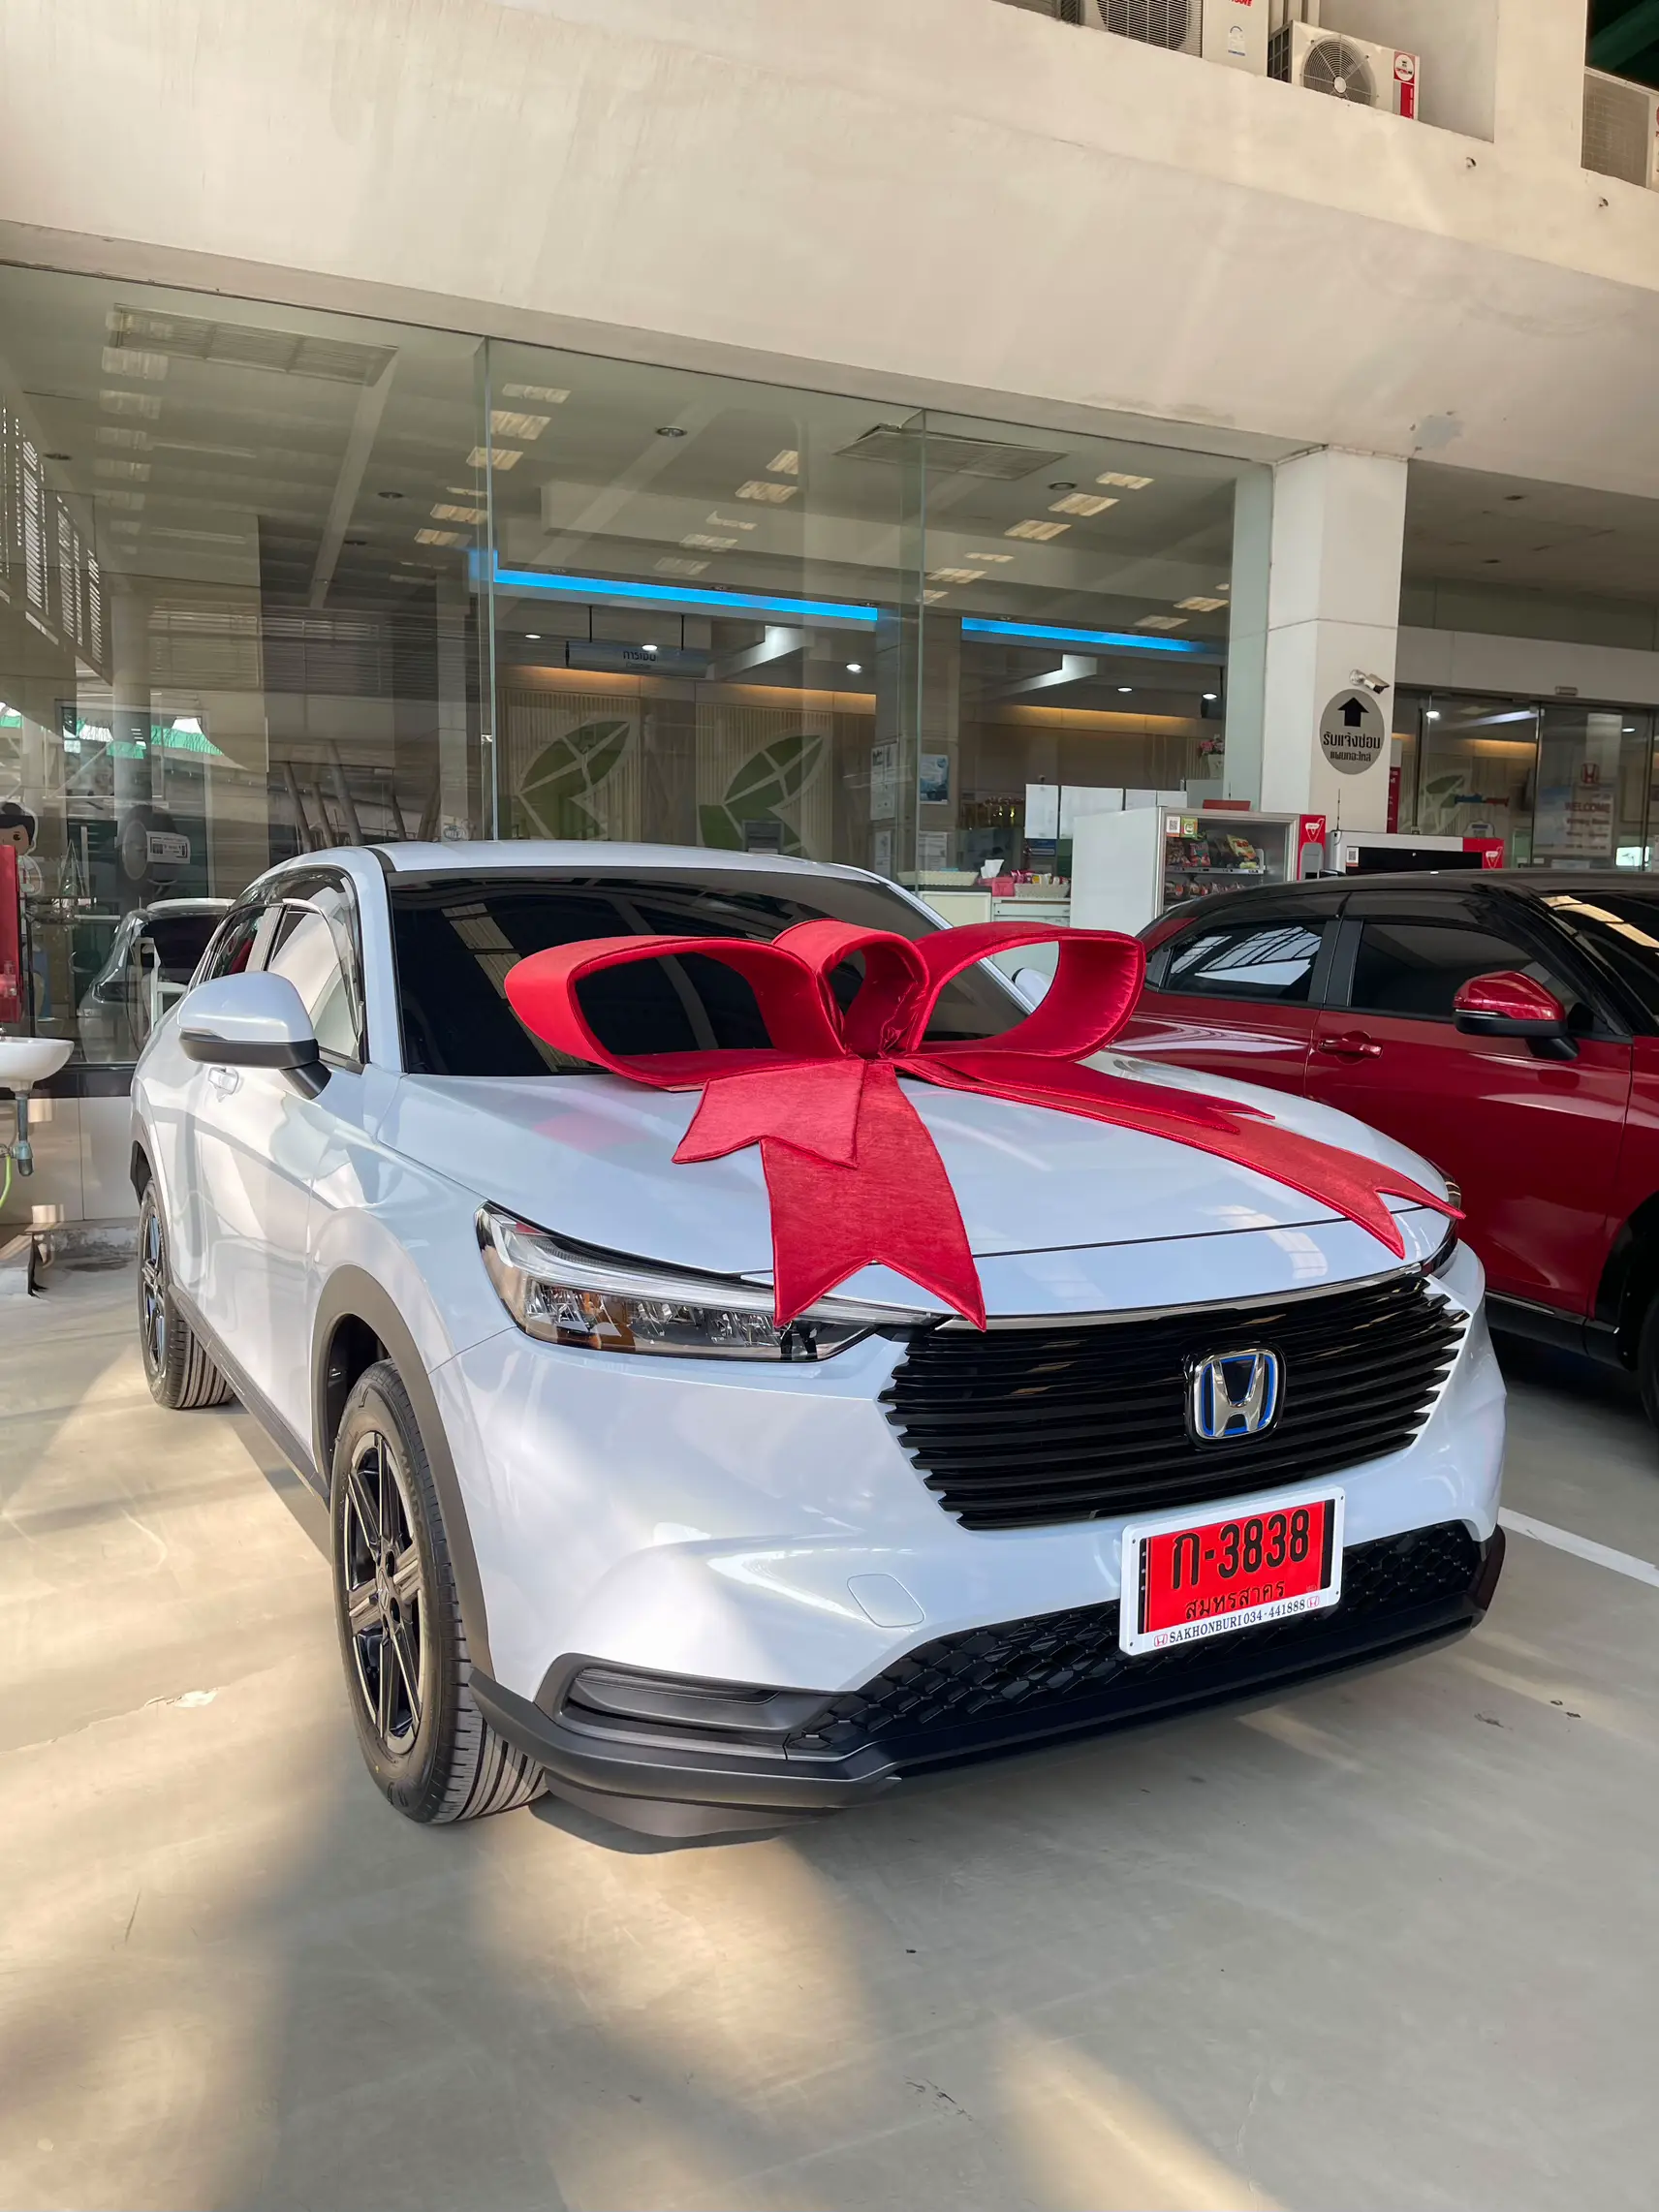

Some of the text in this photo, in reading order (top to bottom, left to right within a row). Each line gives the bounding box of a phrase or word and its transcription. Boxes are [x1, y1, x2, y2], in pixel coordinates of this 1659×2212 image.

[1172, 1509, 1311, 1590] ก-3838
[1185, 1580, 1286, 1620] สมทรสาคร
[1169, 1614, 1242, 1643] SAKHONBURI
